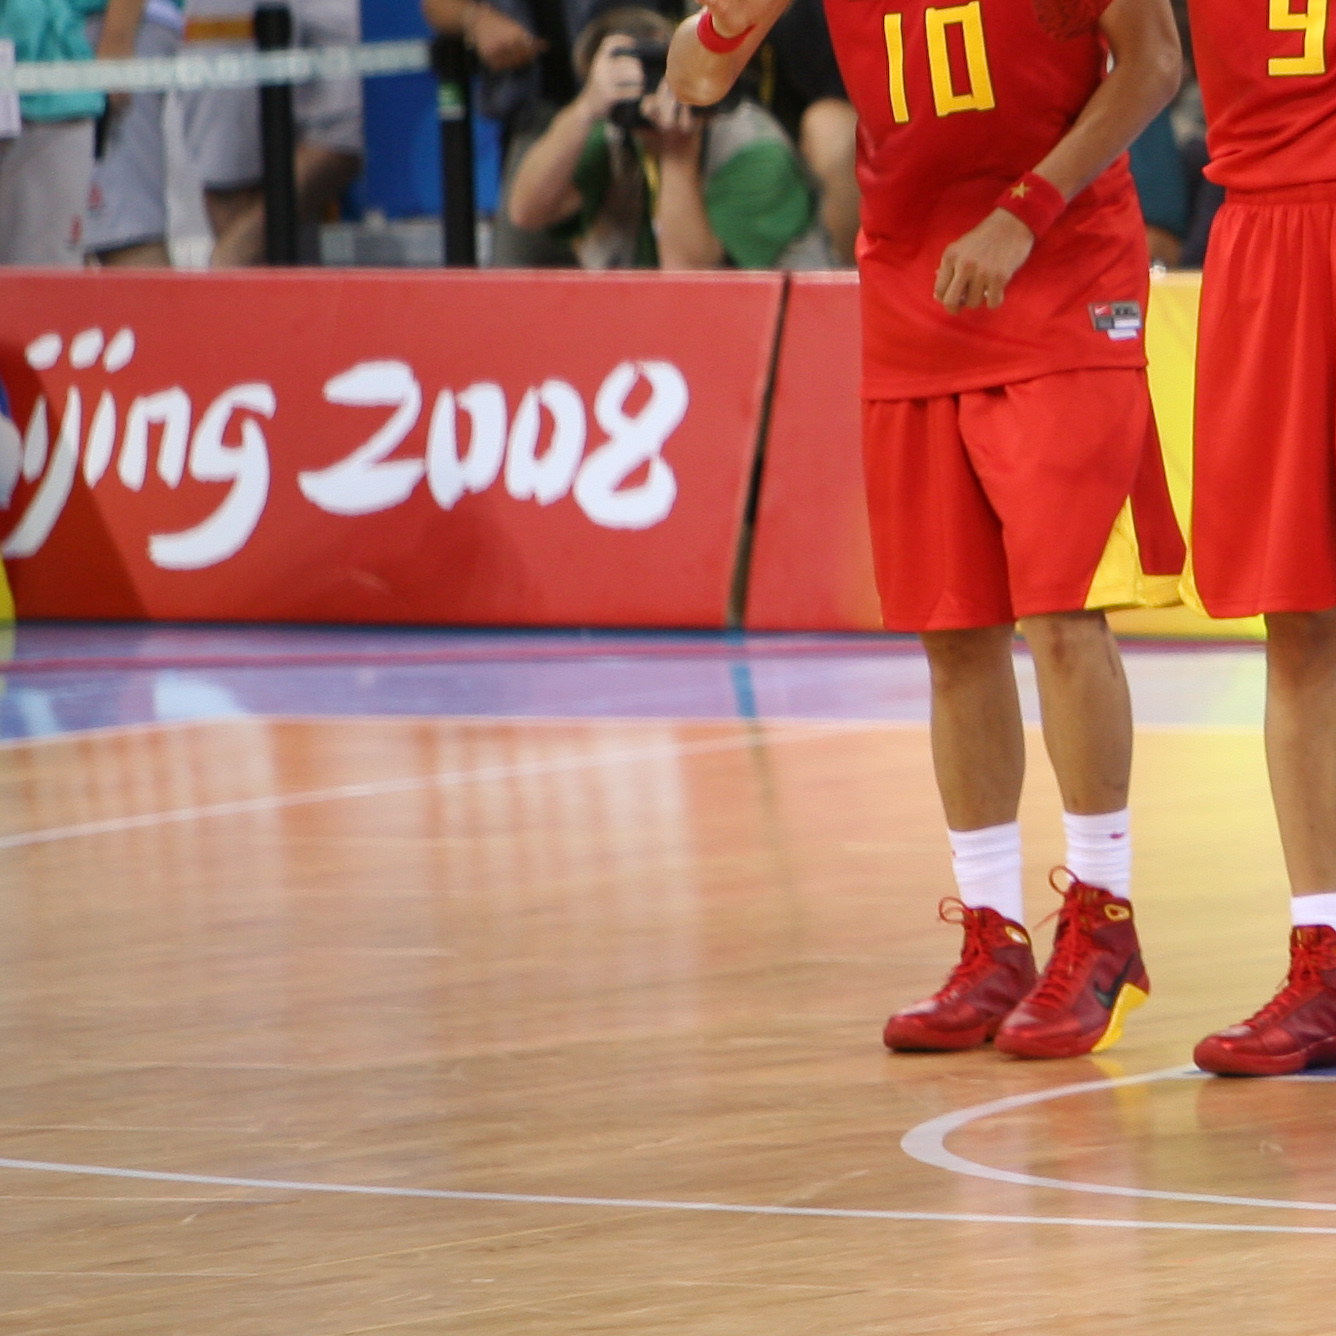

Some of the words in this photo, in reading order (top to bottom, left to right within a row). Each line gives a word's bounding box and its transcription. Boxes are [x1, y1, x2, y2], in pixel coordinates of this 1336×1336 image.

[882, 0, 997, 124] 10
[0, 324, 278, 571] ijing
[297, 358, 690, 531] 2008
